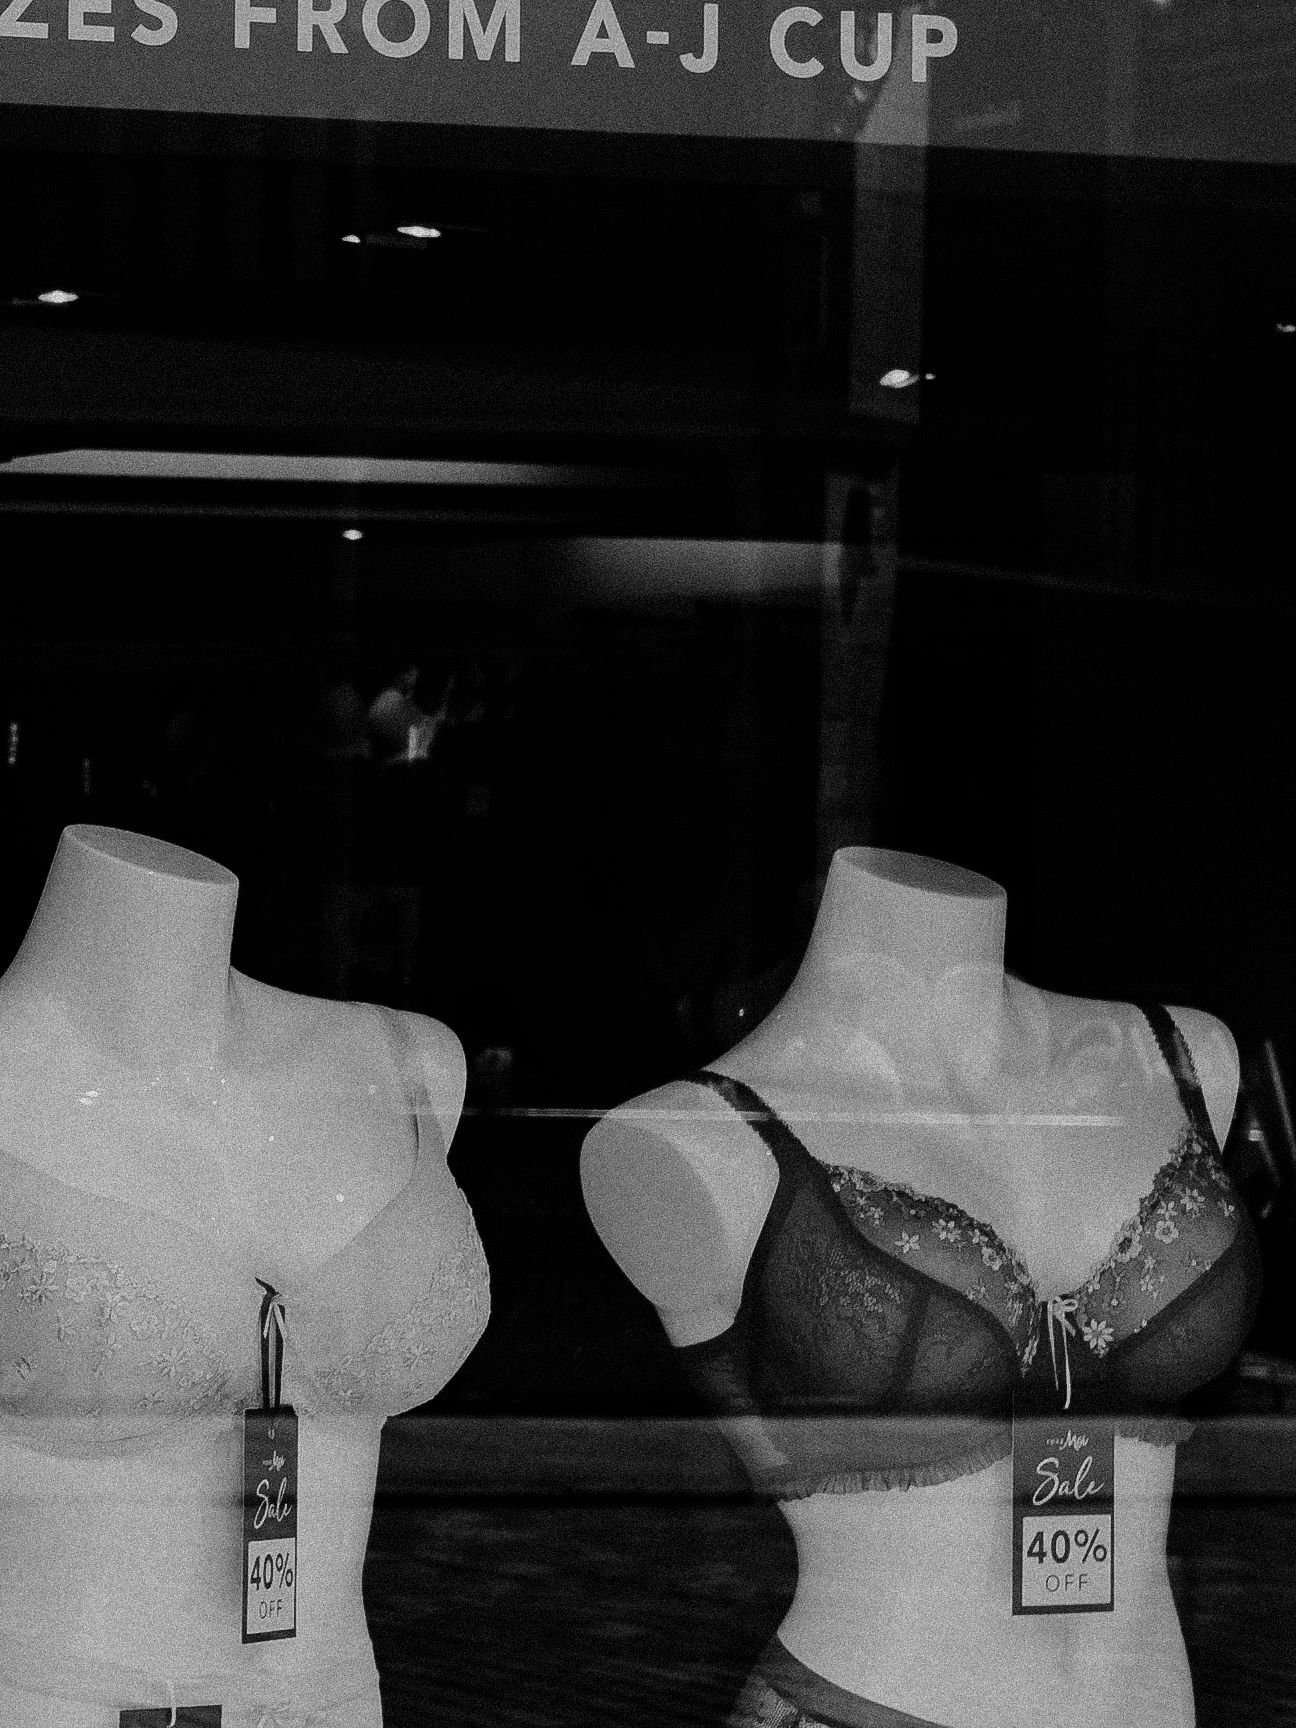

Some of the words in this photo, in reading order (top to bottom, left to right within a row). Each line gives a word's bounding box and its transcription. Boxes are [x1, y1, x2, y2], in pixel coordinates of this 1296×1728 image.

[769, 5, 959, 85] CUP
[1032, 1455, 1105, 1506] Sale
[1026, 1527, 1108, 1564] 40%
[250, 1552, 293, 1590] 40%
[1045, 1573, 1088, 1593] OFF
[259, 1599, 283, 1619] OFF
